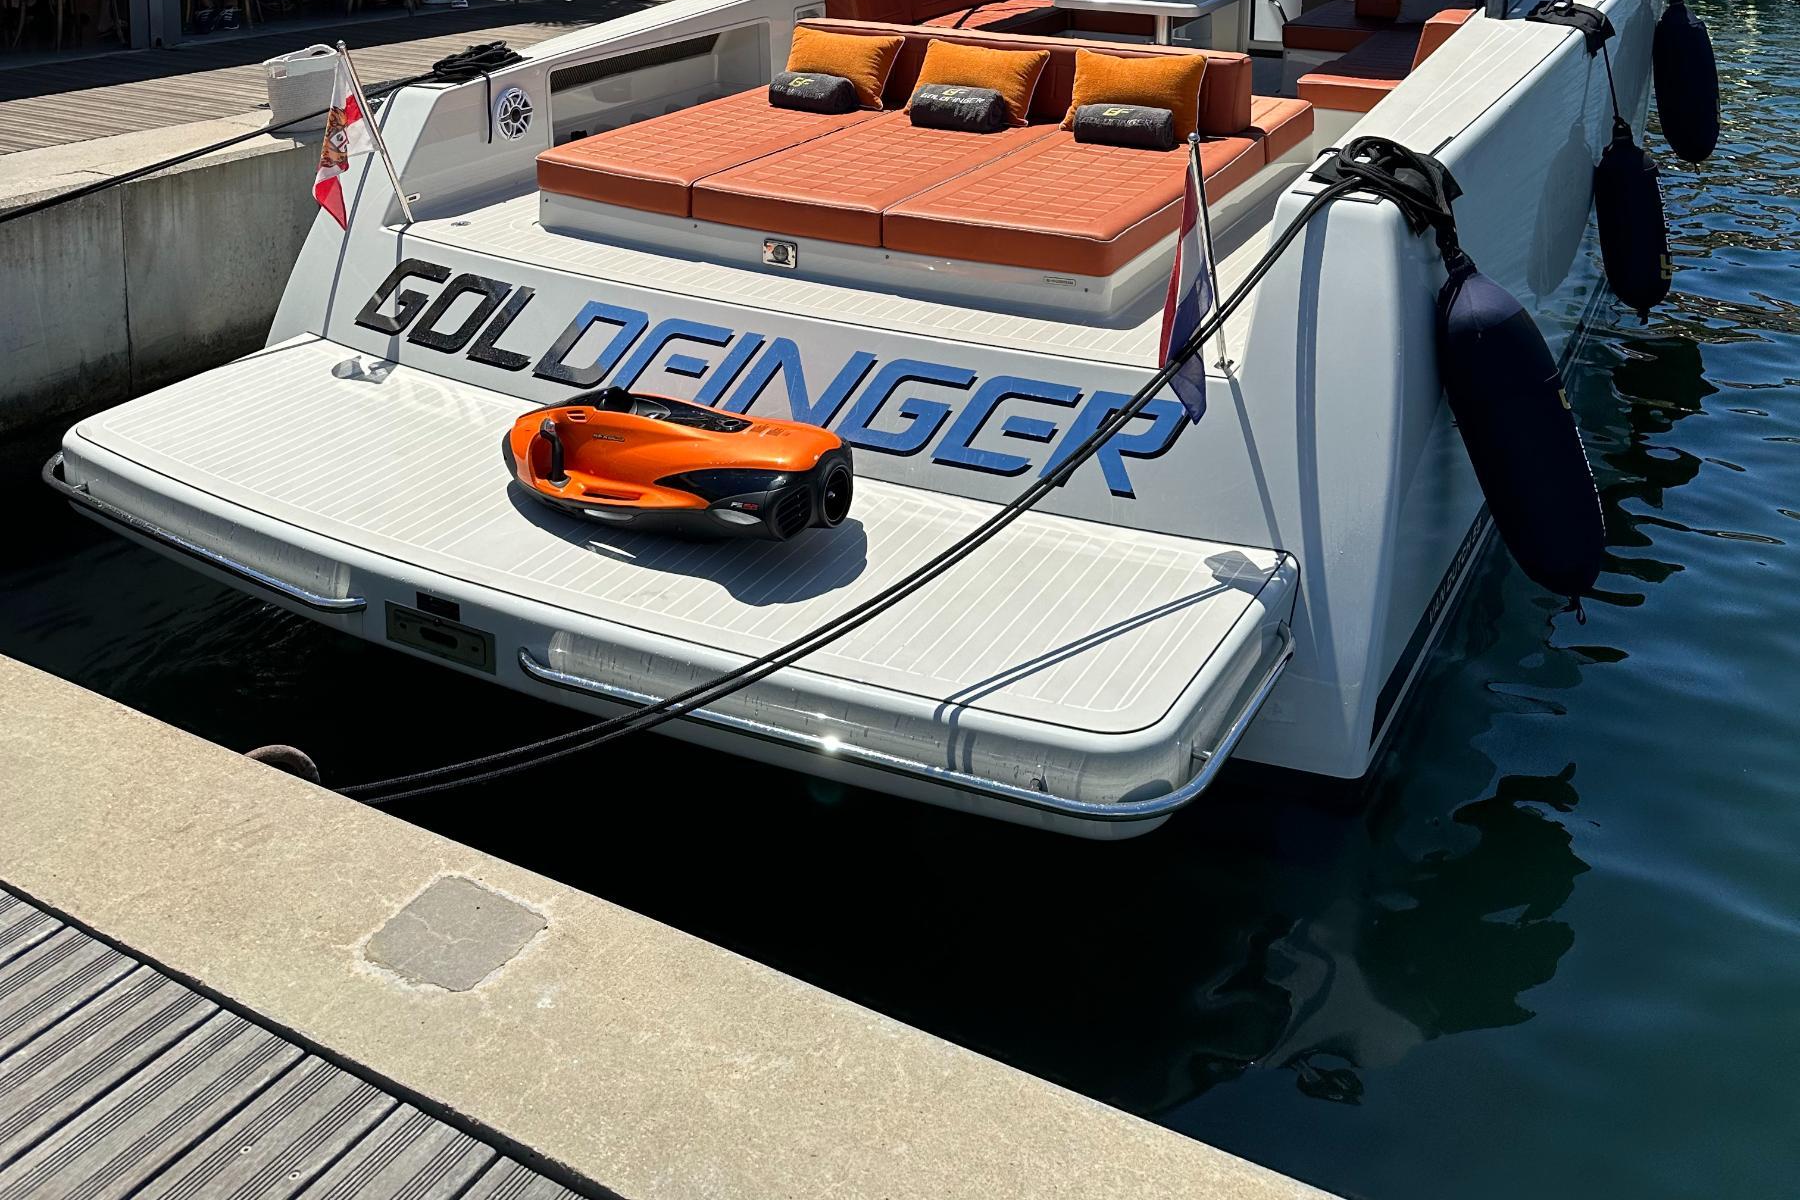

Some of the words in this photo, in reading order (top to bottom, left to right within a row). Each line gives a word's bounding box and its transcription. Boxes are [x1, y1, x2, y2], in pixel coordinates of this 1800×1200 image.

[919, 92, 986, 104] GOLDFINGER
[1102, 107, 1136, 117] GF
[354, 257, 1189, 499] GOLDFINGER
